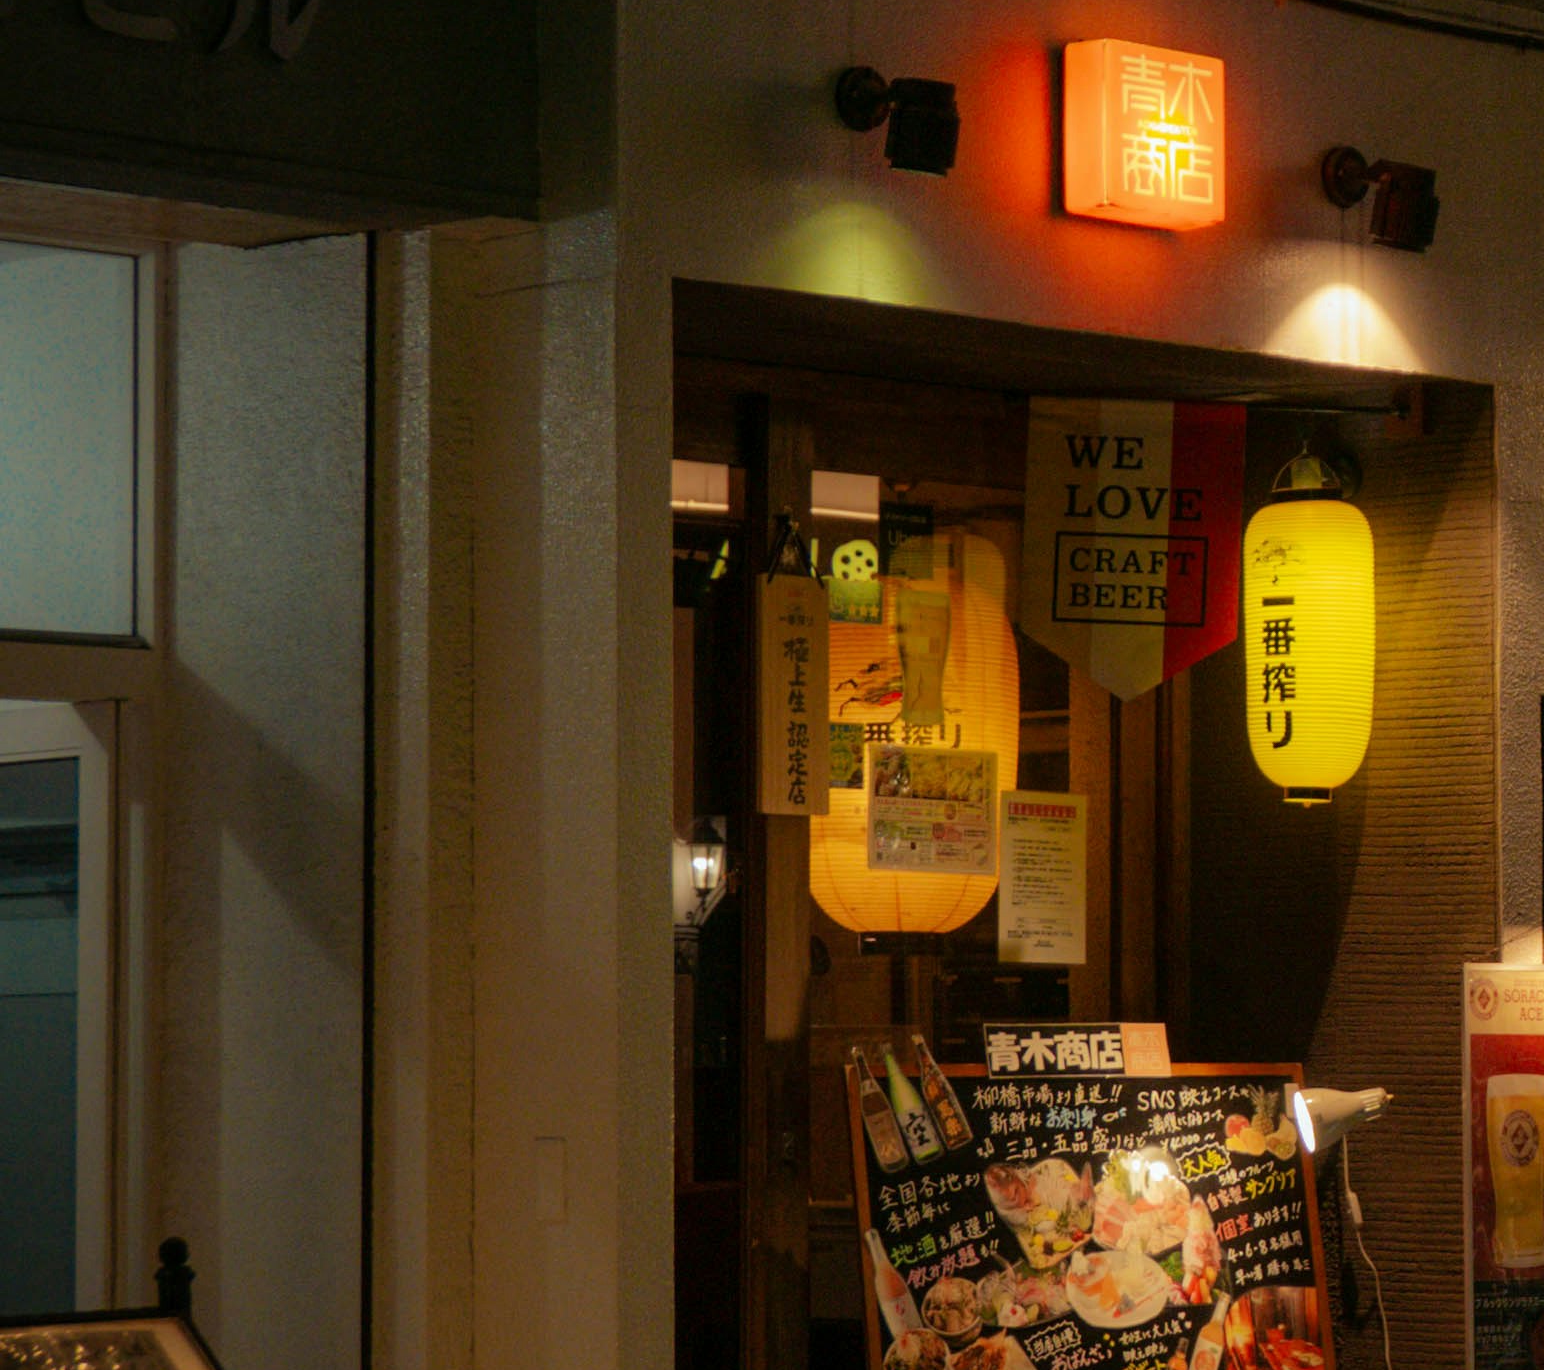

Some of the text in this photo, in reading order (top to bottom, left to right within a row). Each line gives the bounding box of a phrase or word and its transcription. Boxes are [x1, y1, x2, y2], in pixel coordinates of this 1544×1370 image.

[1120, 53, 1214, 125] 青木
[1120, 130, 1214, 205] 商店
[1065, 435, 1144, 470] WE
[1064, 484, 1203, 521] LOVE
[1069, 548, 1196, 576] CRAFT
[1068, 583, 1168, 610] BEER
[1262, 596, 1296, 749] 一番搾り
[1519, 1007, 1544, 1021] ACE
[987, 1031, 1123, 1072] 青木商店
[989, 1105, 1097, 1136] 新鮮なお刺身
[1183, 1149, 1228, 1178] 大人気
[878, 1172, 981, 1211] 全国各地より
